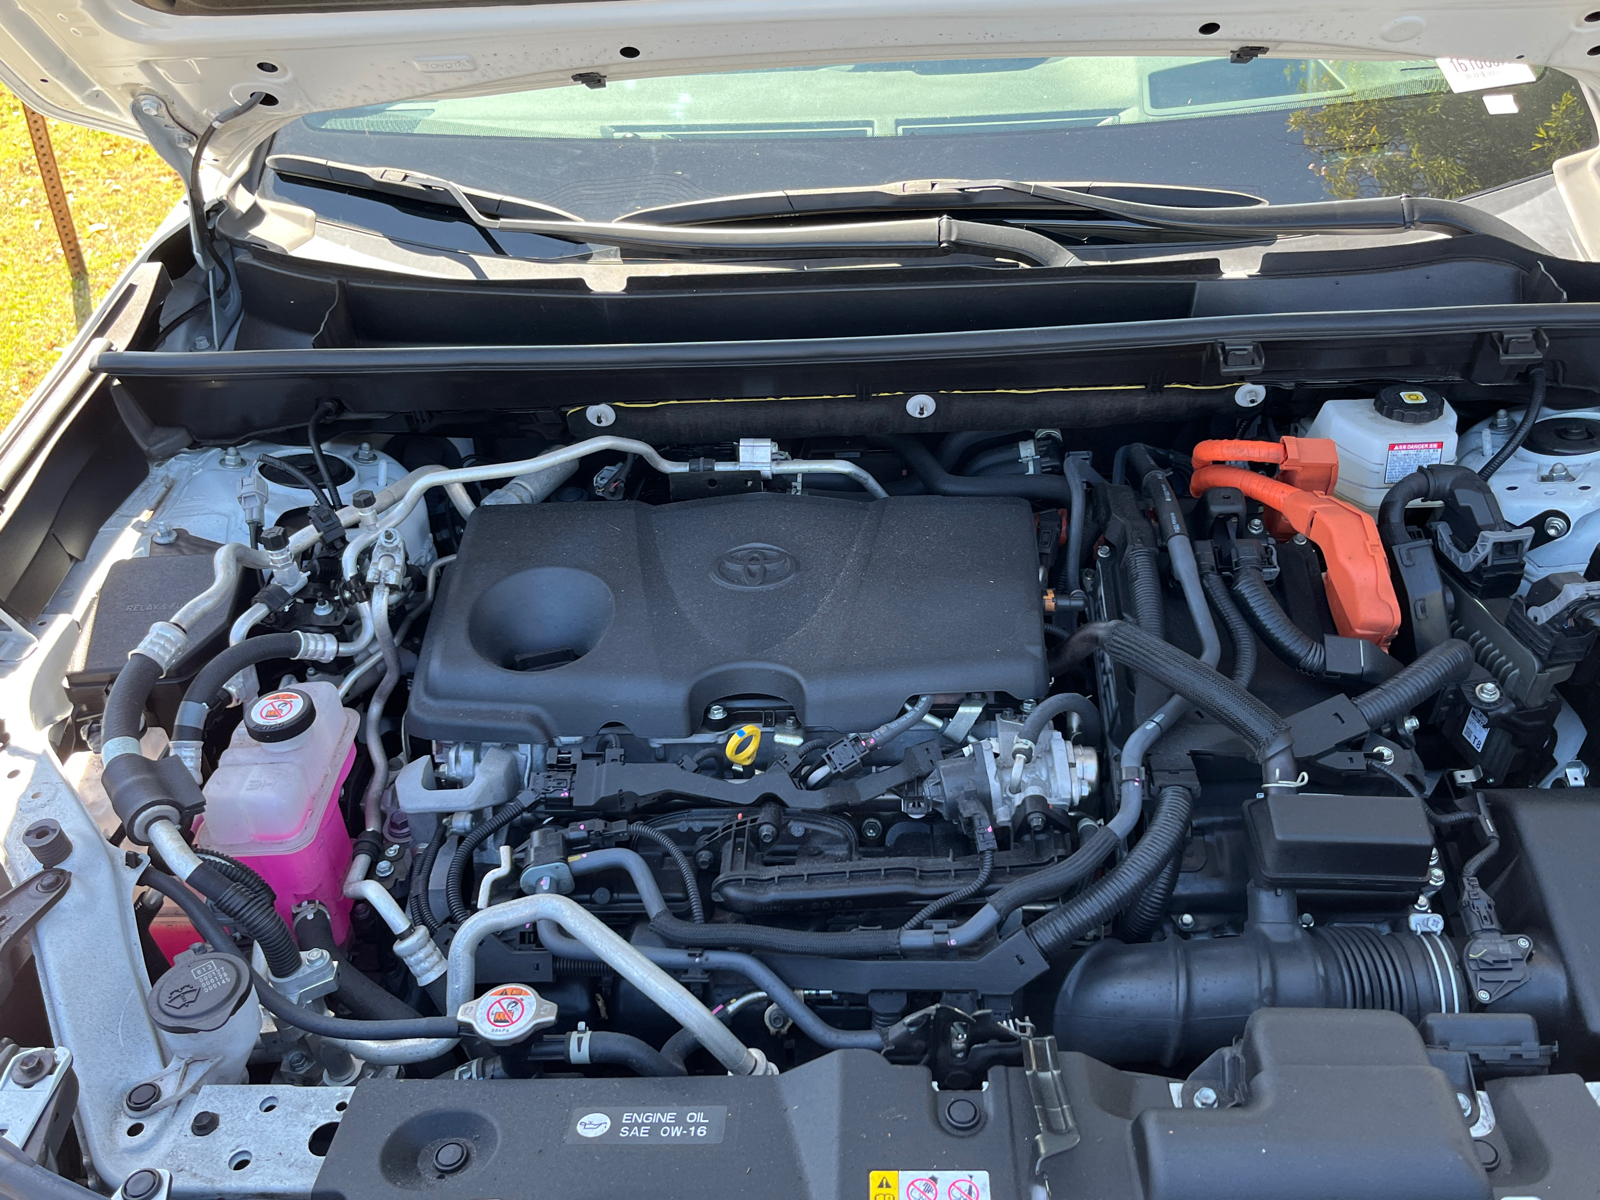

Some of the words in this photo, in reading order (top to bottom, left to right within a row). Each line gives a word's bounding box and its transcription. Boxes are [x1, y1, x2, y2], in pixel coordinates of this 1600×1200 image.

[422, 61, 468, 70] TOYOTA
[126, 604, 160, 612] RELAY
[199, 966, 226, 983] 000127
[622, 1112, 677, 1124] ENGINE
[686, 1112, 710, 1123] OIL
[619, 1126, 651, 1138] SAE
